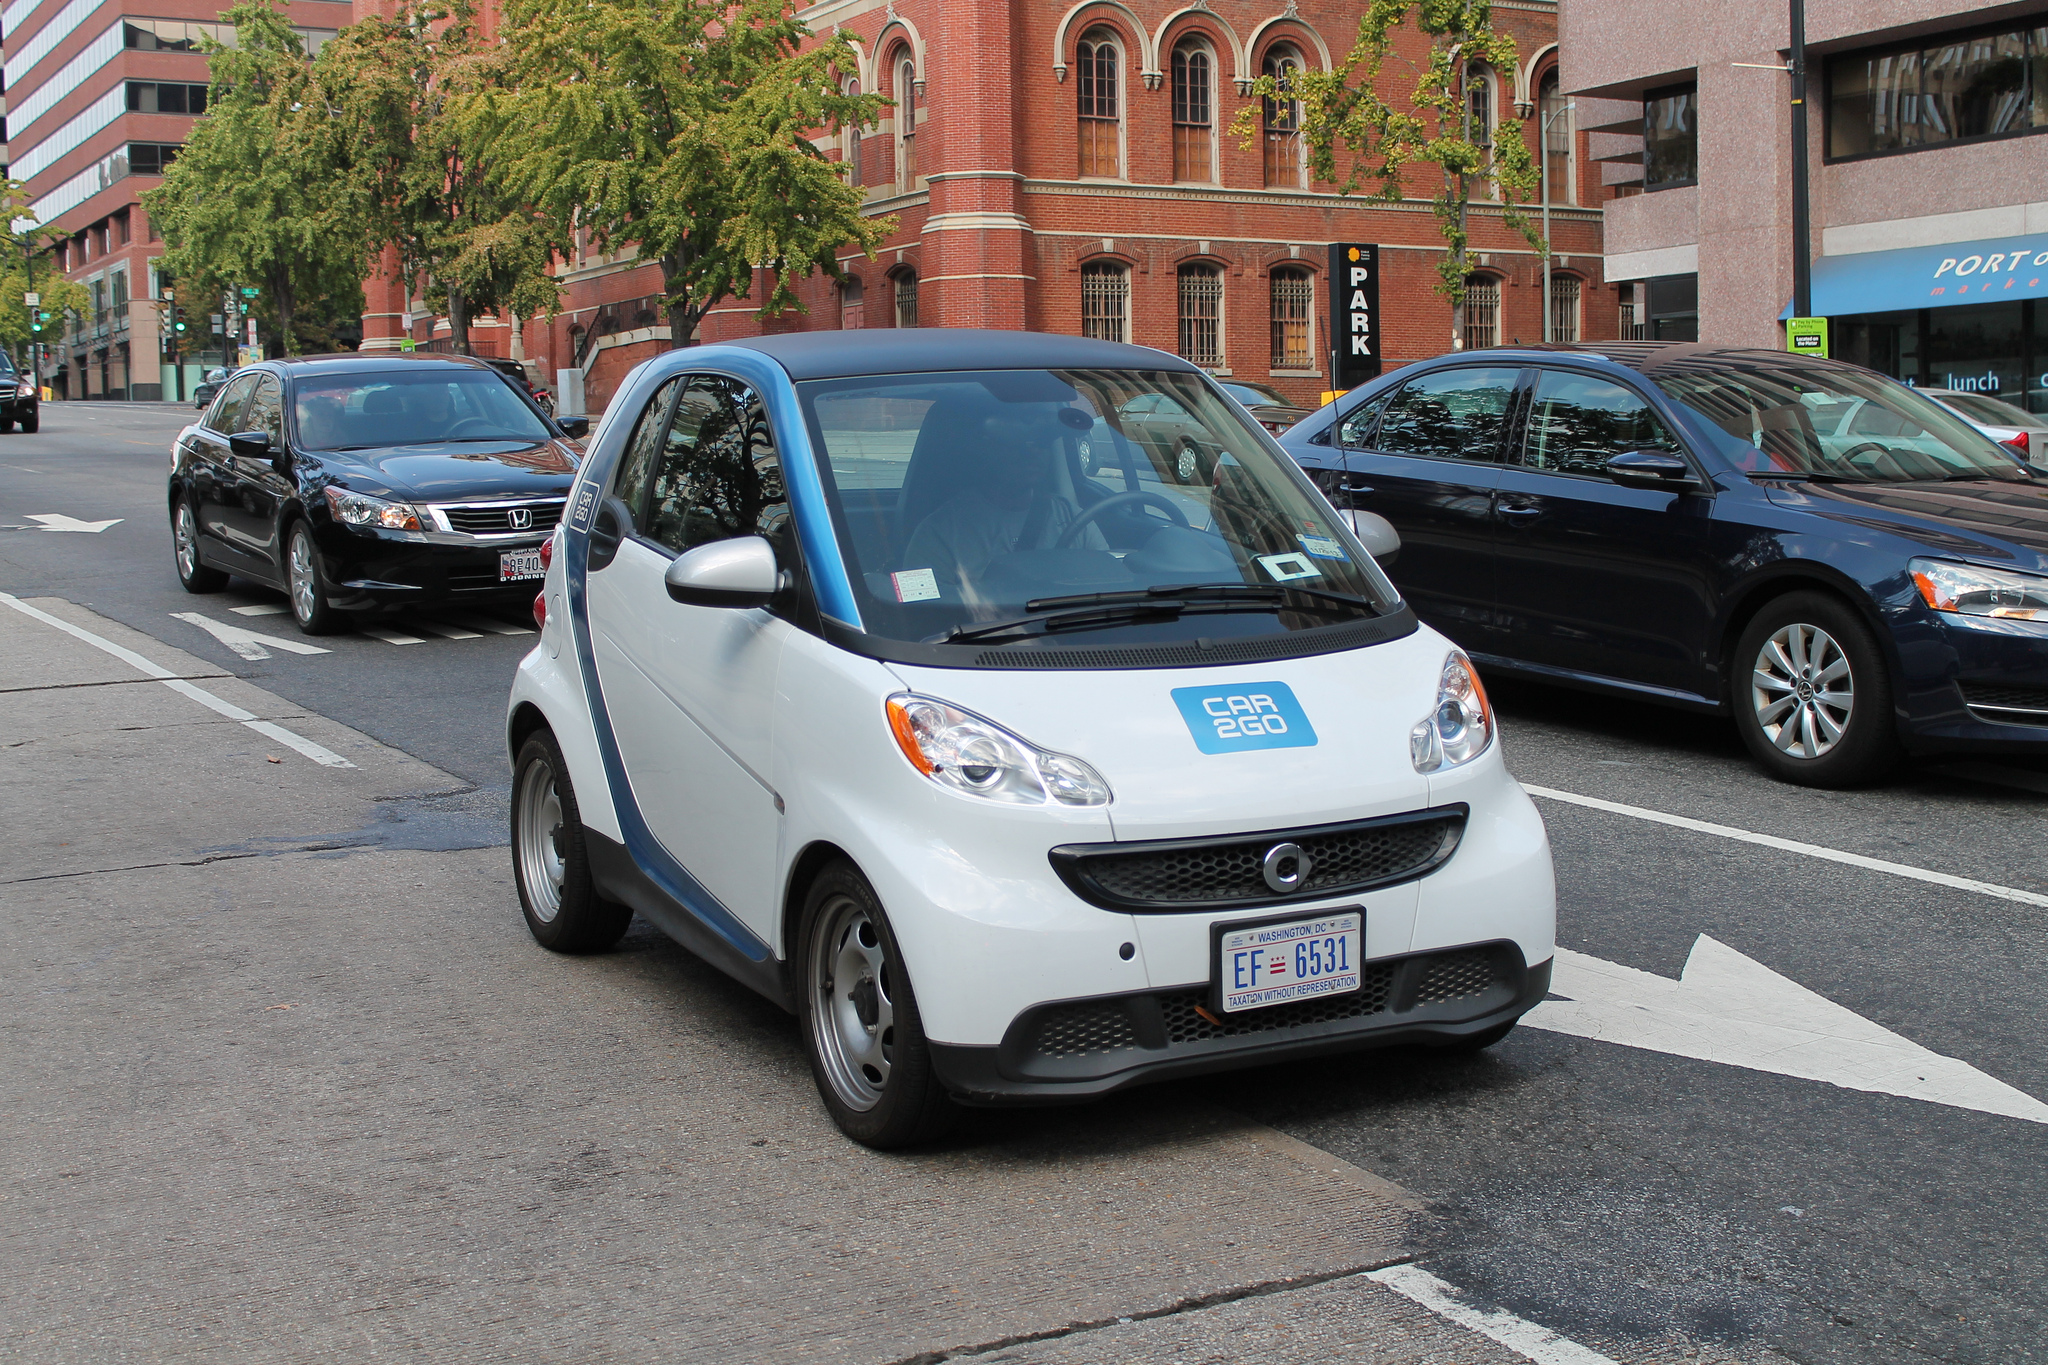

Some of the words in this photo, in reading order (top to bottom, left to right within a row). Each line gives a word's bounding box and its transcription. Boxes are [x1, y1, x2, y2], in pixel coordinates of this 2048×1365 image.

[1933, 250, 2032, 278] PORT
[1349, 266, 1371, 355] PARK
[1948, 370, 1999, 391] lunch
[1202, 694, 1279, 717] CAR
[1213, 714, 1288, 739] 2GO
[1315, 922, 1327, 934] DC
[1234, 949, 1264, 989] EF
[1295, 935, 1349, 979] 6531
[1228, 991, 1263, 1007] TAXATION
[1264, 986, 1296, 1000] WITHOUT
[1297, 975, 1357, 995] REPRESENTATION
